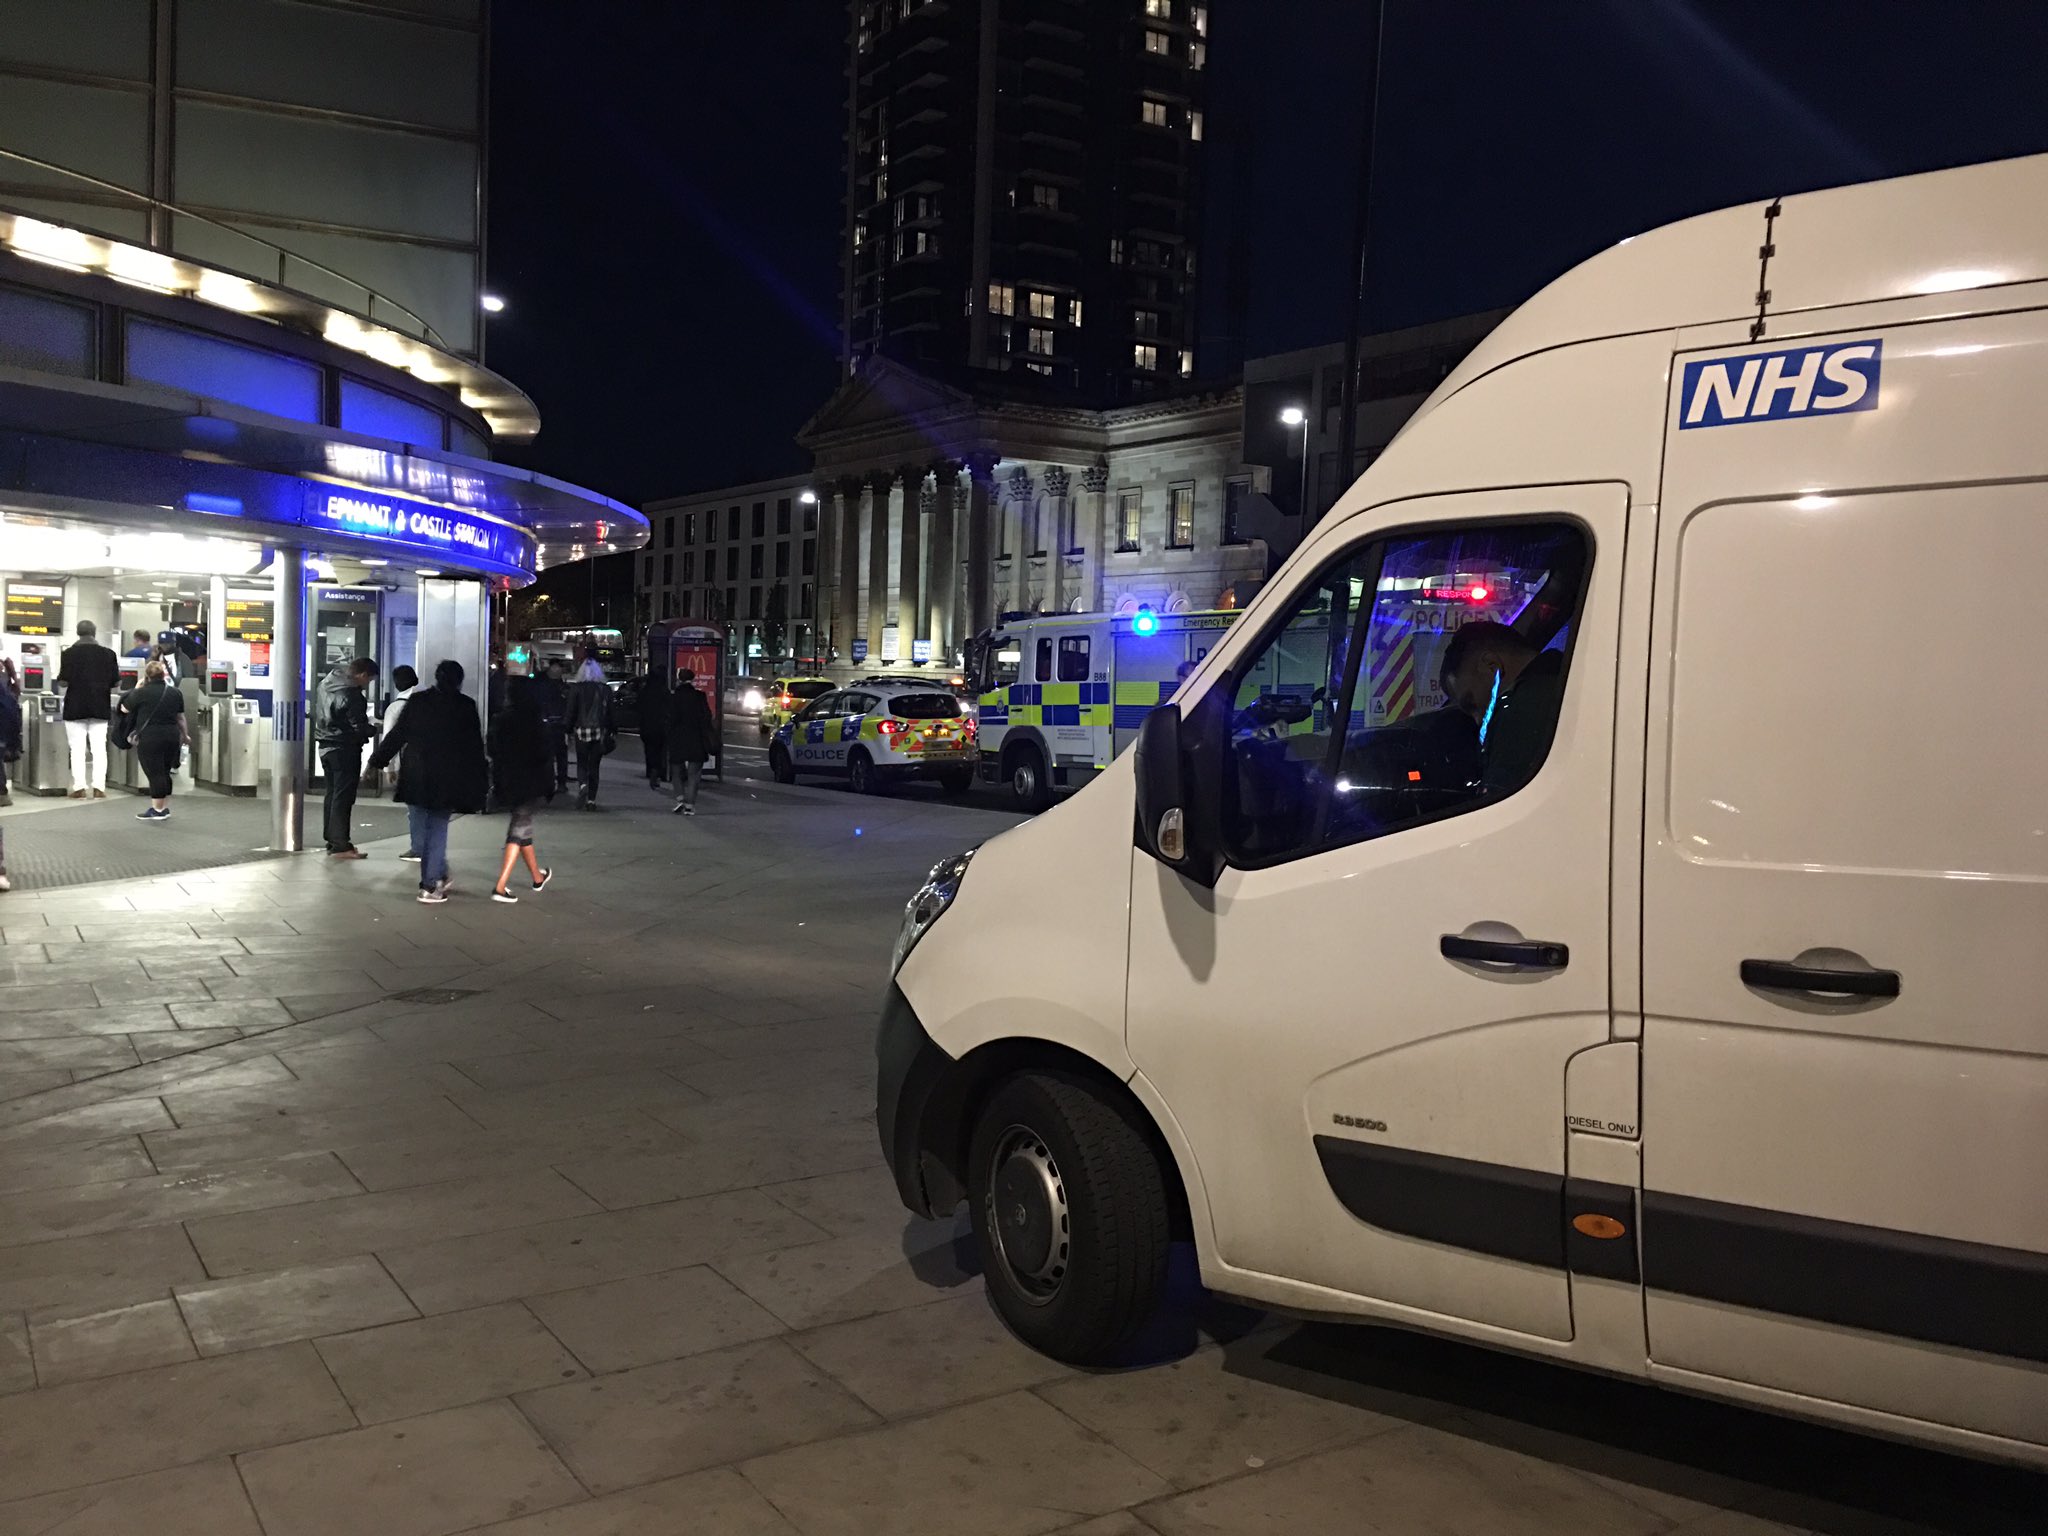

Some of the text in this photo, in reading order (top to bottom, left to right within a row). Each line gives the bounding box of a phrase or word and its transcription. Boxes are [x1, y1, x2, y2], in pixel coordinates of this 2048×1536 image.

[1686, 345, 1876, 423] NHS
[395, 509, 406, 531] &
[410, 512, 452, 541] CASTLE
[454, 522, 491, 549] STATION
[325, 591, 366, 602] Assistance
[1183, 617, 1220, 629] Emergency
[795, 750, 845, 761] POLICE
[1569, 1115, 1636, 1135] DIESEL ONLY
